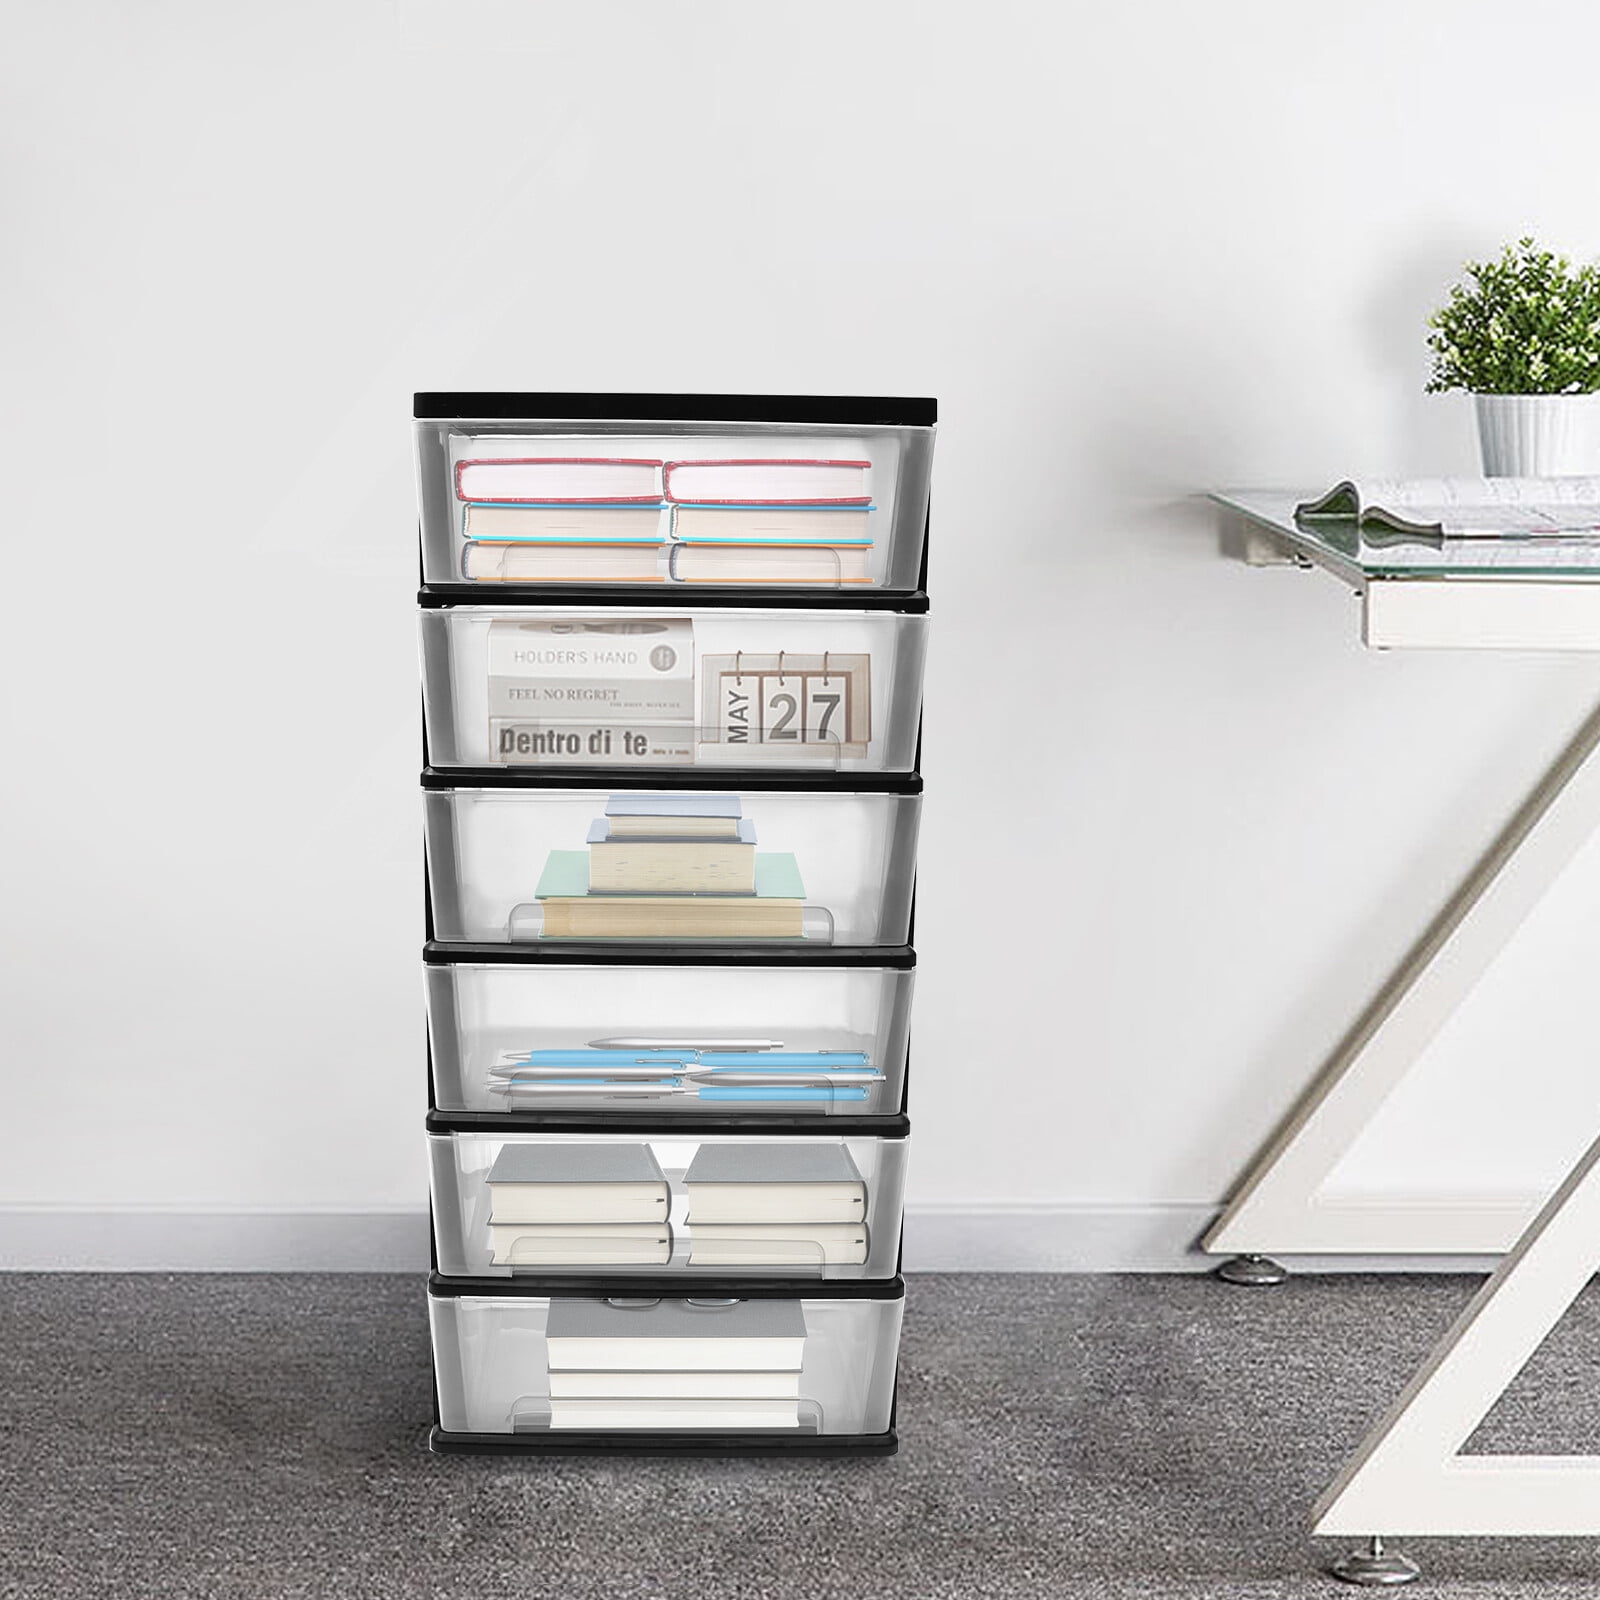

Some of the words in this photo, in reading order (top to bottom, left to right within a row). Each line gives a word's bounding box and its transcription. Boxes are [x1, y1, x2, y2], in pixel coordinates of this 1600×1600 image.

[514, 650, 588, 664] HOLDER'S
[594, 651, 638, 664] HAND
[508, 688, 539, 700] FEEL
[543, 688, 564, 700] NO
[567, 689, 619, 700] REGRET
[727, 690, 749, 743] MAY
[500, 728, 581, 754] Dentro
[588, 729, 612, 755] di
[623, 731, 648, 756] te
